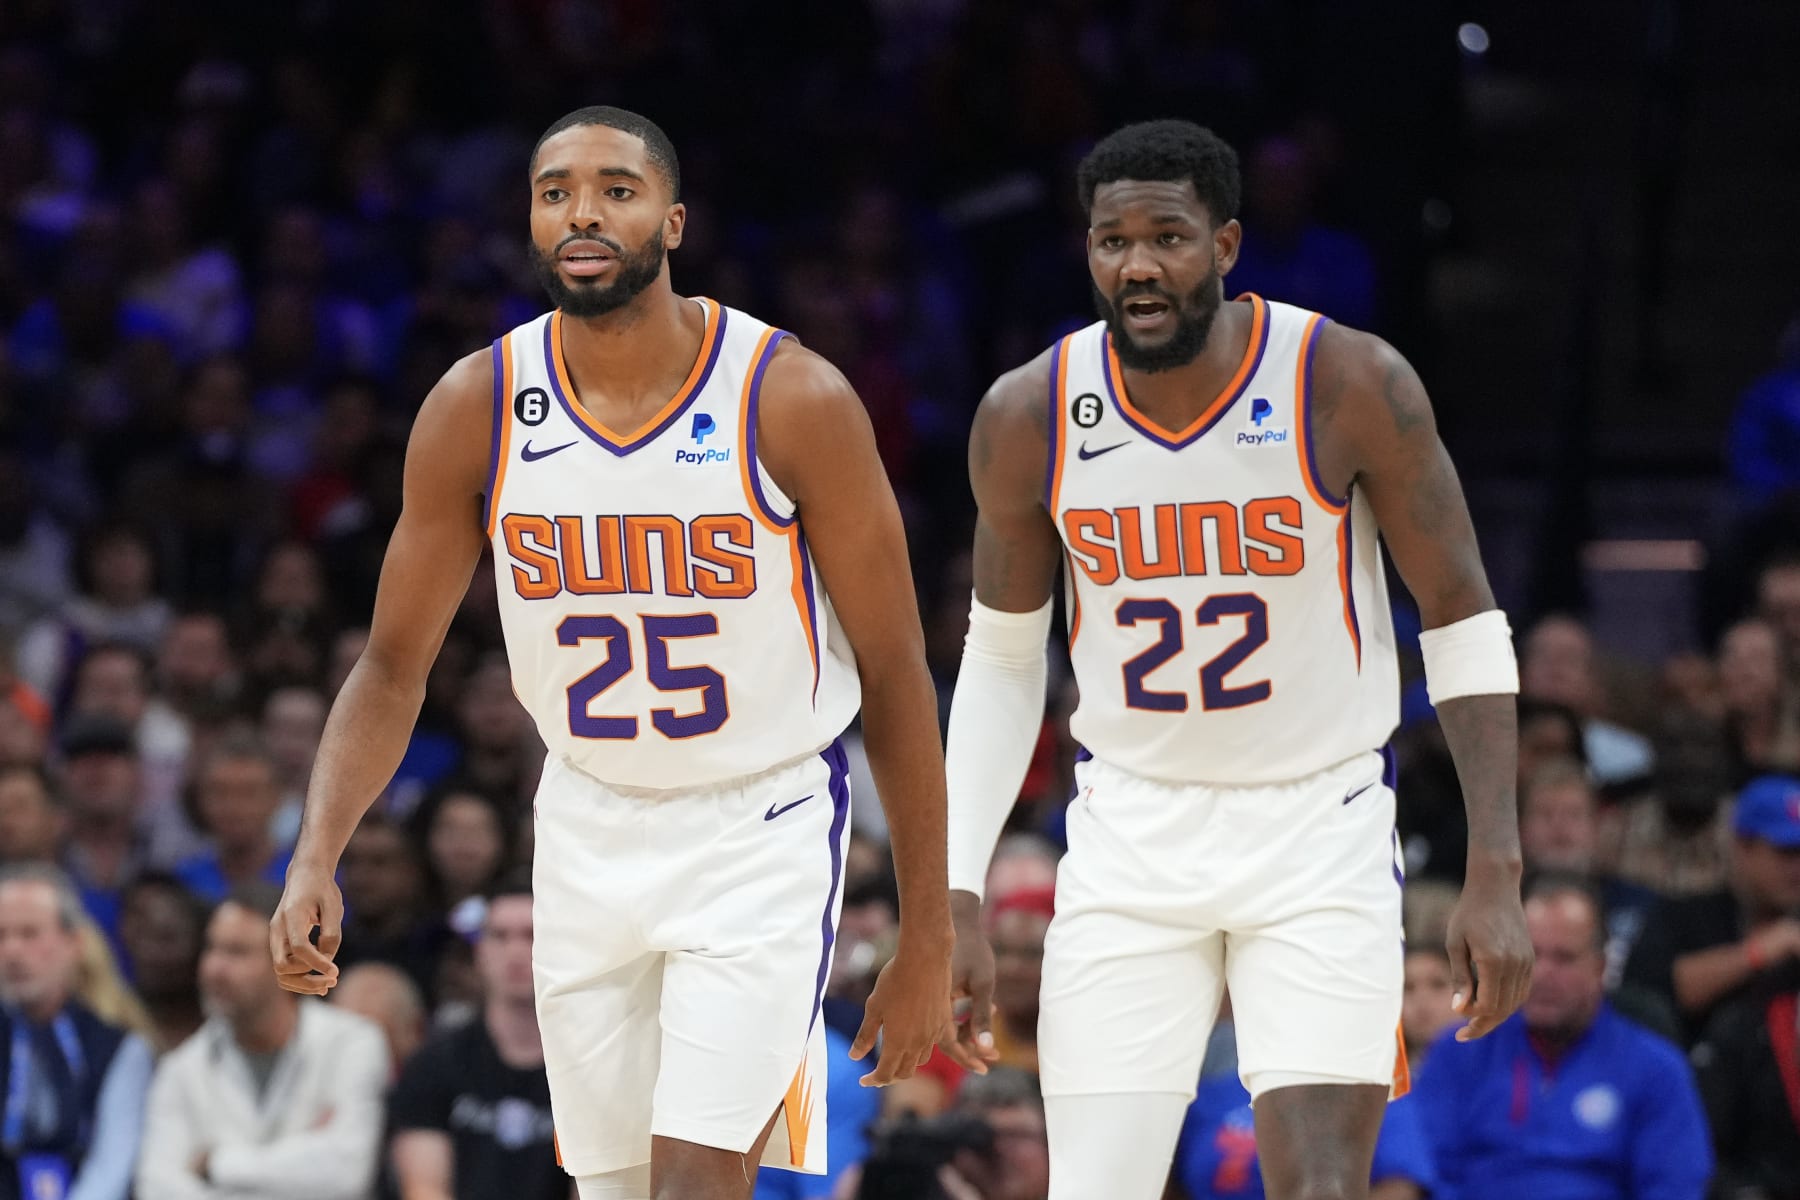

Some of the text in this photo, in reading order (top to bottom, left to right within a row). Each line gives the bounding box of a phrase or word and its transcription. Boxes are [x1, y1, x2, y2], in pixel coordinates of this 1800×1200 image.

[522, 393, 543, 422] 6
[1077, 397, 1098, 424] 6
[1236, 429, 1287, 446] PayPal
[675, 447, 730, 465] PayPal
[1115, 591, 1272, 713] 22
[555, 612, 731, 741] 25
